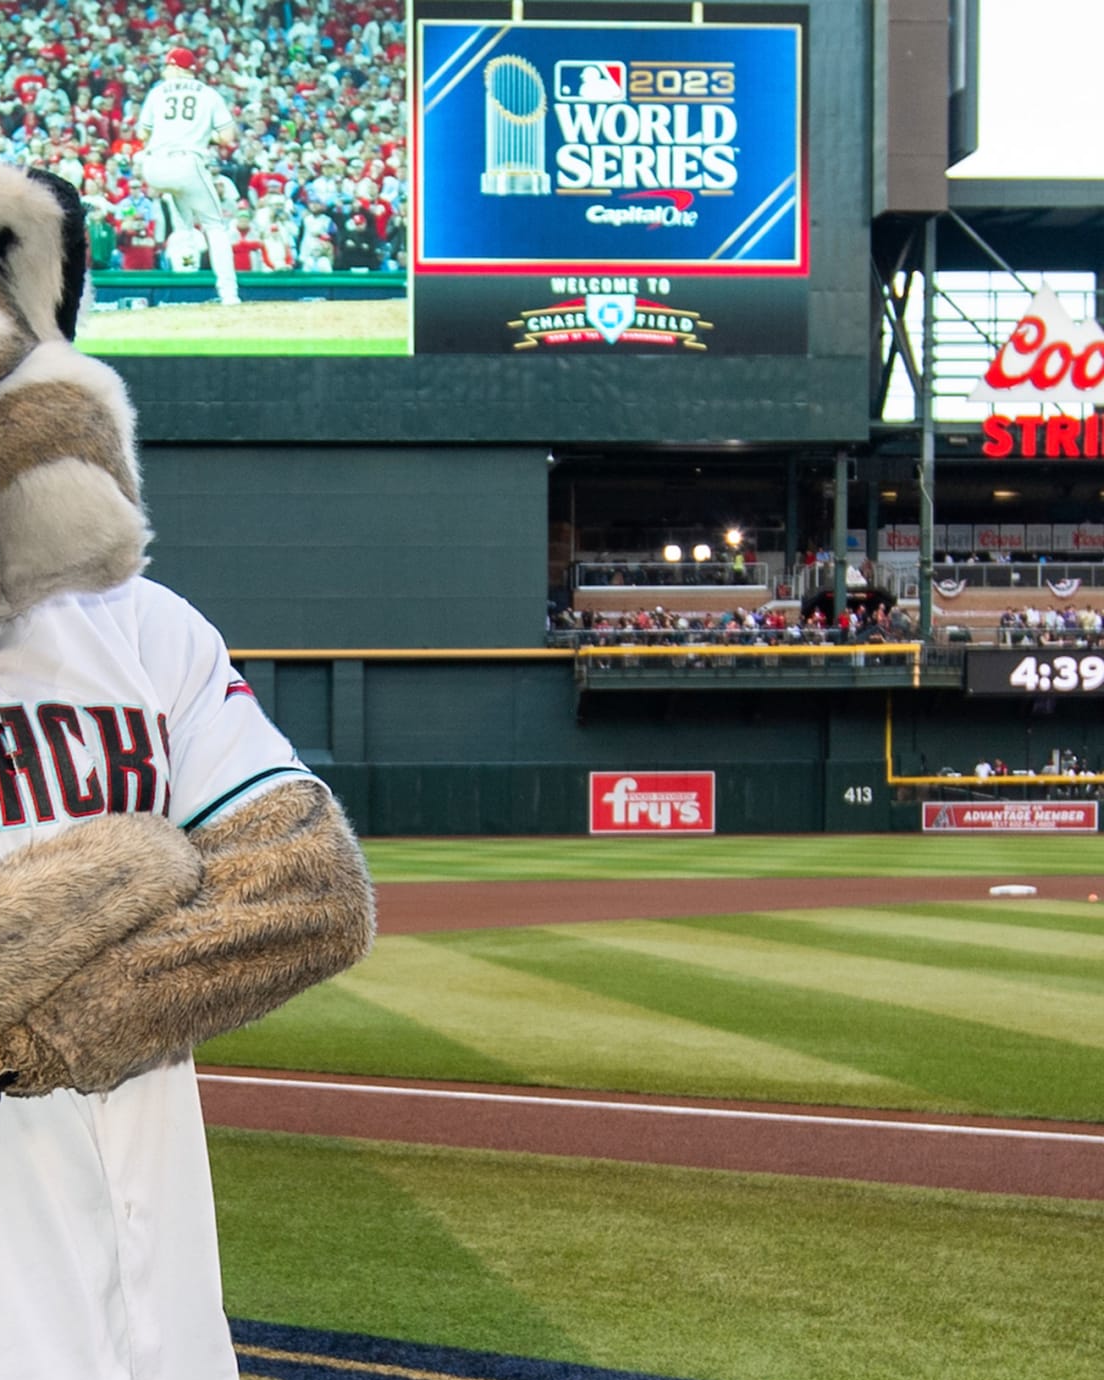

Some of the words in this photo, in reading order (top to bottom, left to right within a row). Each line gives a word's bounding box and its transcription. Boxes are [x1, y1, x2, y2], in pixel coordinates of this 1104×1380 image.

[630, 70, 735, 95] 2023
[164, 95, 196, 121] 38
[554, 104, 738, 145] WORLD
[555, 145, 738, 189] SERIES
[550, 276, 639, 295] WELCOME
[647, 277, 671, 295] TO
[527, 312, 586, 332] CHASE
[636, 312, 694, 332] FIELD
[981, 414, 1104, 458] STRI
[1010, 655, 1104, 692] 4:39
[602, 776, 701, 828] fry's
[844, 786, 873, 804] 413
[963, 811, 1032, 822] ADVANTAGE
[1034, 810, 1086, 822] MEMBER
